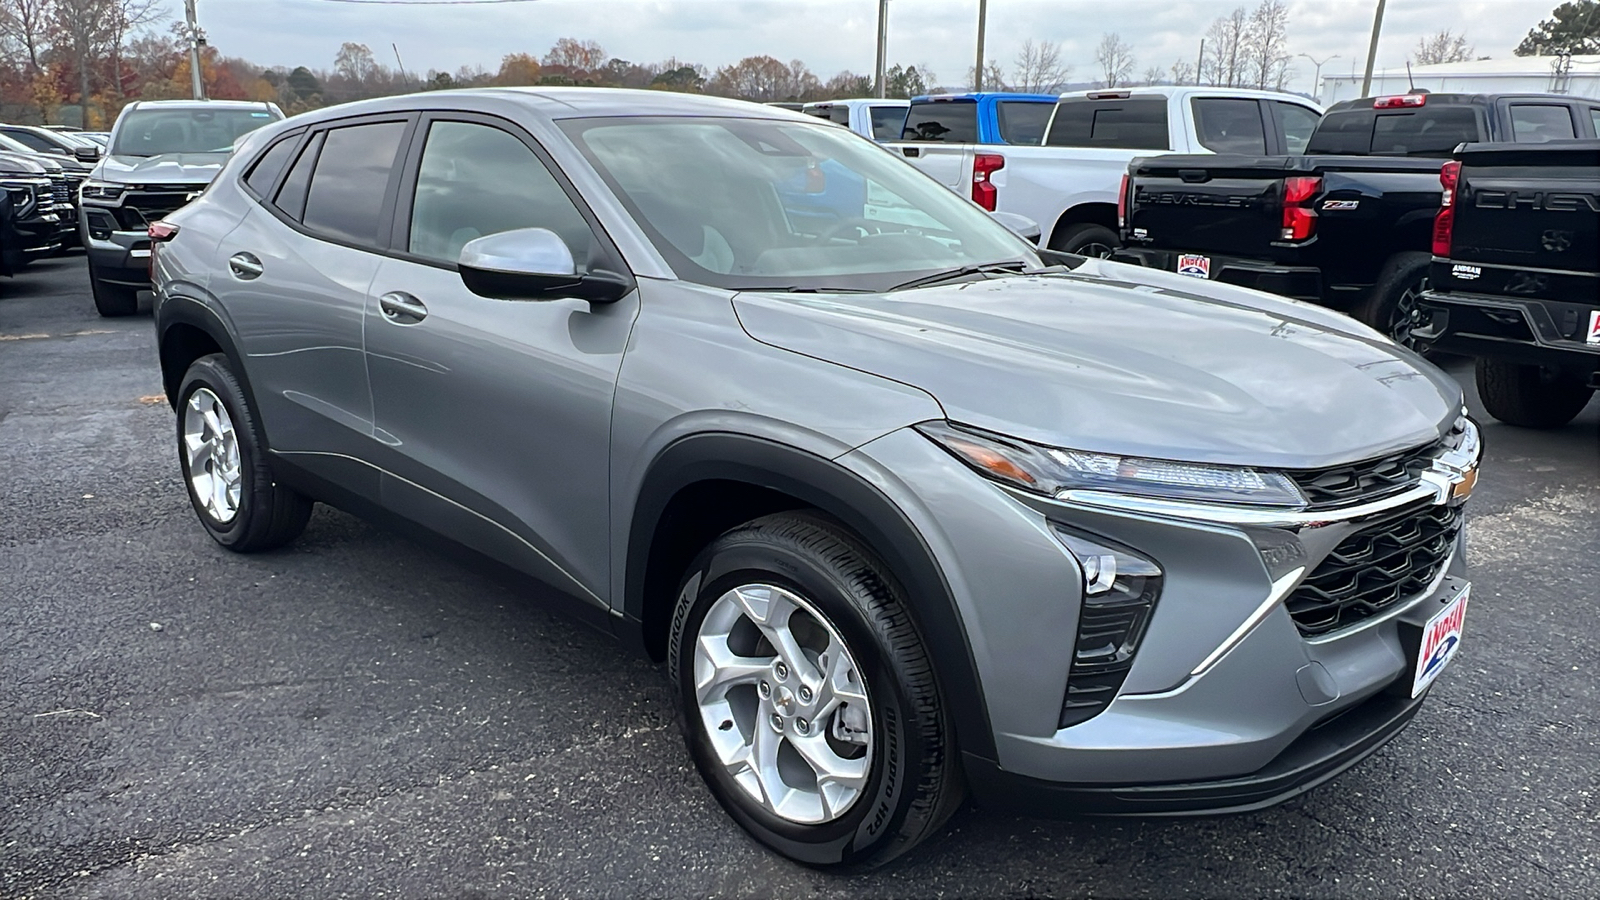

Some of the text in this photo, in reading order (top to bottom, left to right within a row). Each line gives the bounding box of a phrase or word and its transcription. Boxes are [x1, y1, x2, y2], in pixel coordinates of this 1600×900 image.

[1136, 192, 1257, 208] CHEVROLET
[1180, 256, 1208, 272] ANDEAN
[1421, 597, 1467, 674] ANDEAN
[867, 801, 889, 836] HP2
